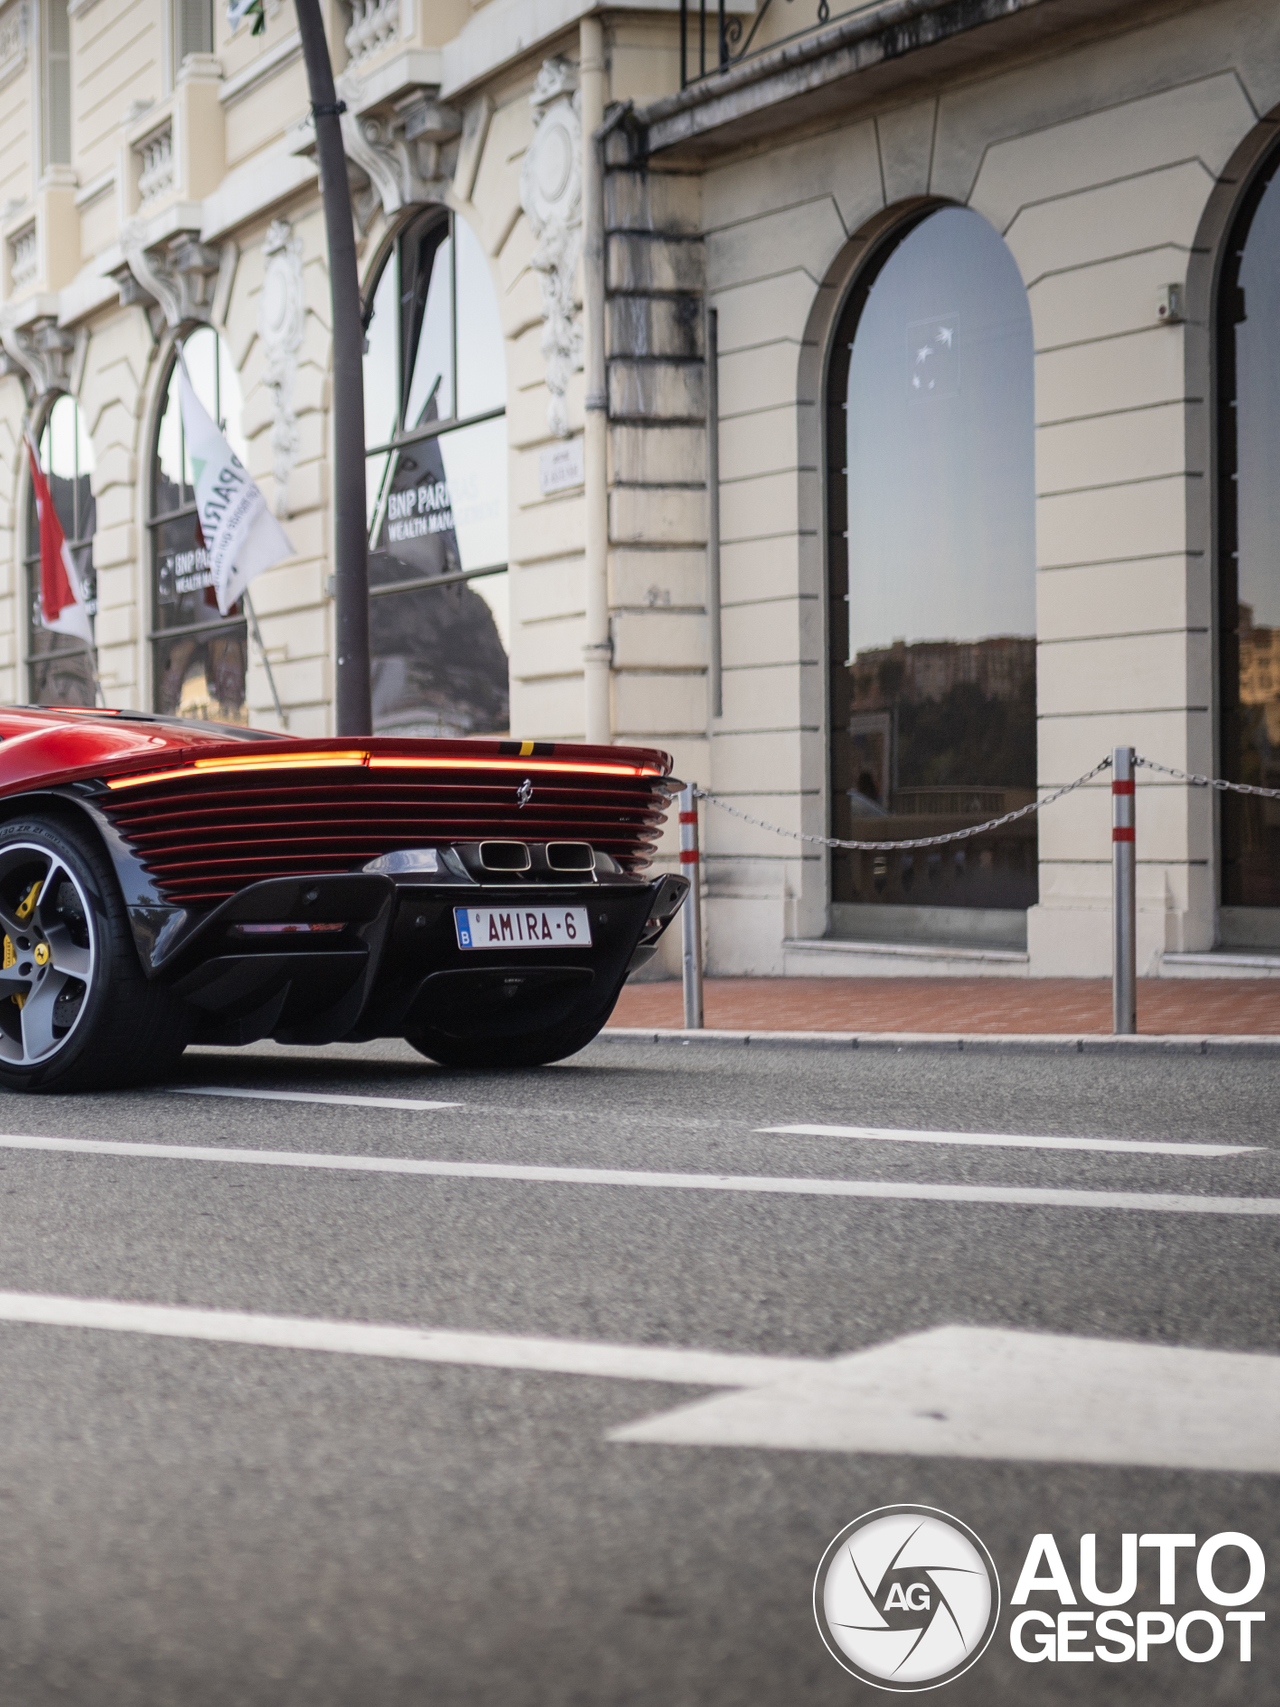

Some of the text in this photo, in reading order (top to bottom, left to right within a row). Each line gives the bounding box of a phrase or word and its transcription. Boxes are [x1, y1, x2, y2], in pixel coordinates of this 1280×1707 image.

[388, 488, 416, 520] BNP
[388, 516, 427, 542] WEALTH
[175, 550, 194, 577] BNP
[175, 573, 201, 594] WEALTH
[461, 912, 577, 944] B AMIRA-6
